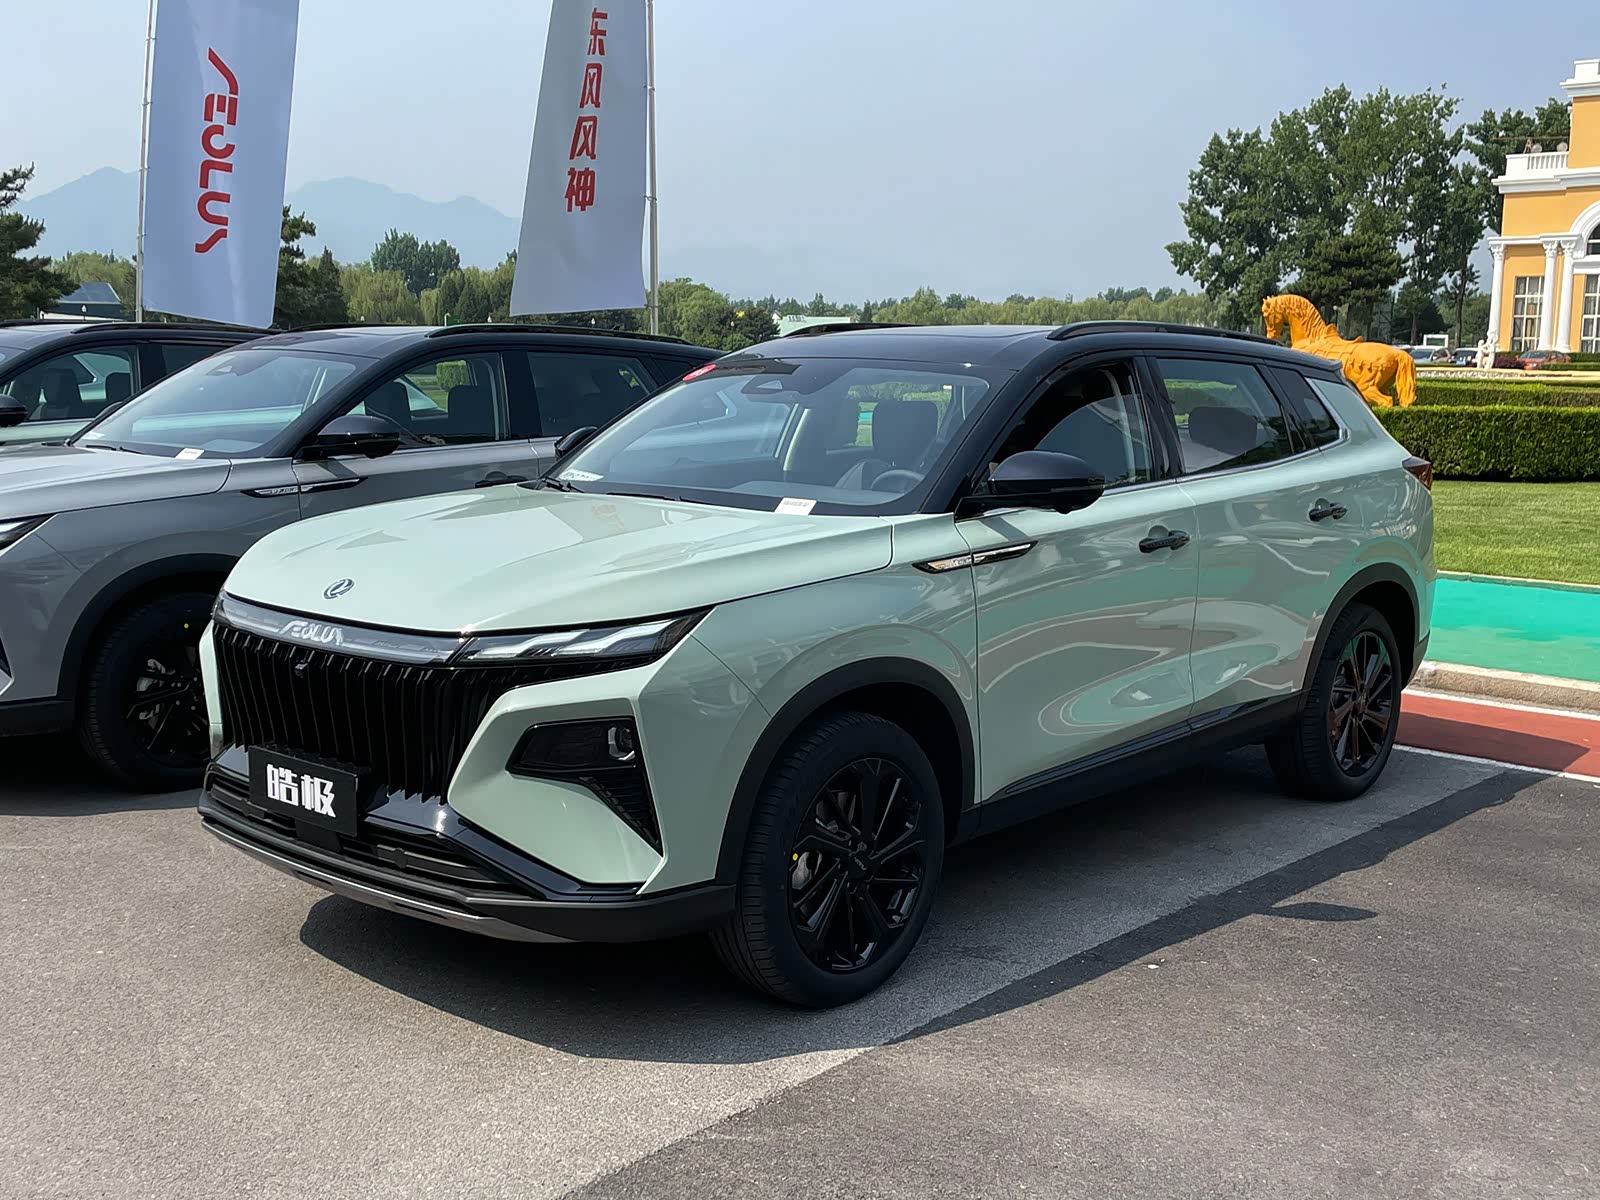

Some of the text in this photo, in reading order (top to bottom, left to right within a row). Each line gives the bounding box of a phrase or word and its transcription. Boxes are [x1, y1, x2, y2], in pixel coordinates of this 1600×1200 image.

[564, 7, 609, 213] 东风风神
[266, 763, 337, 818] 皓极
